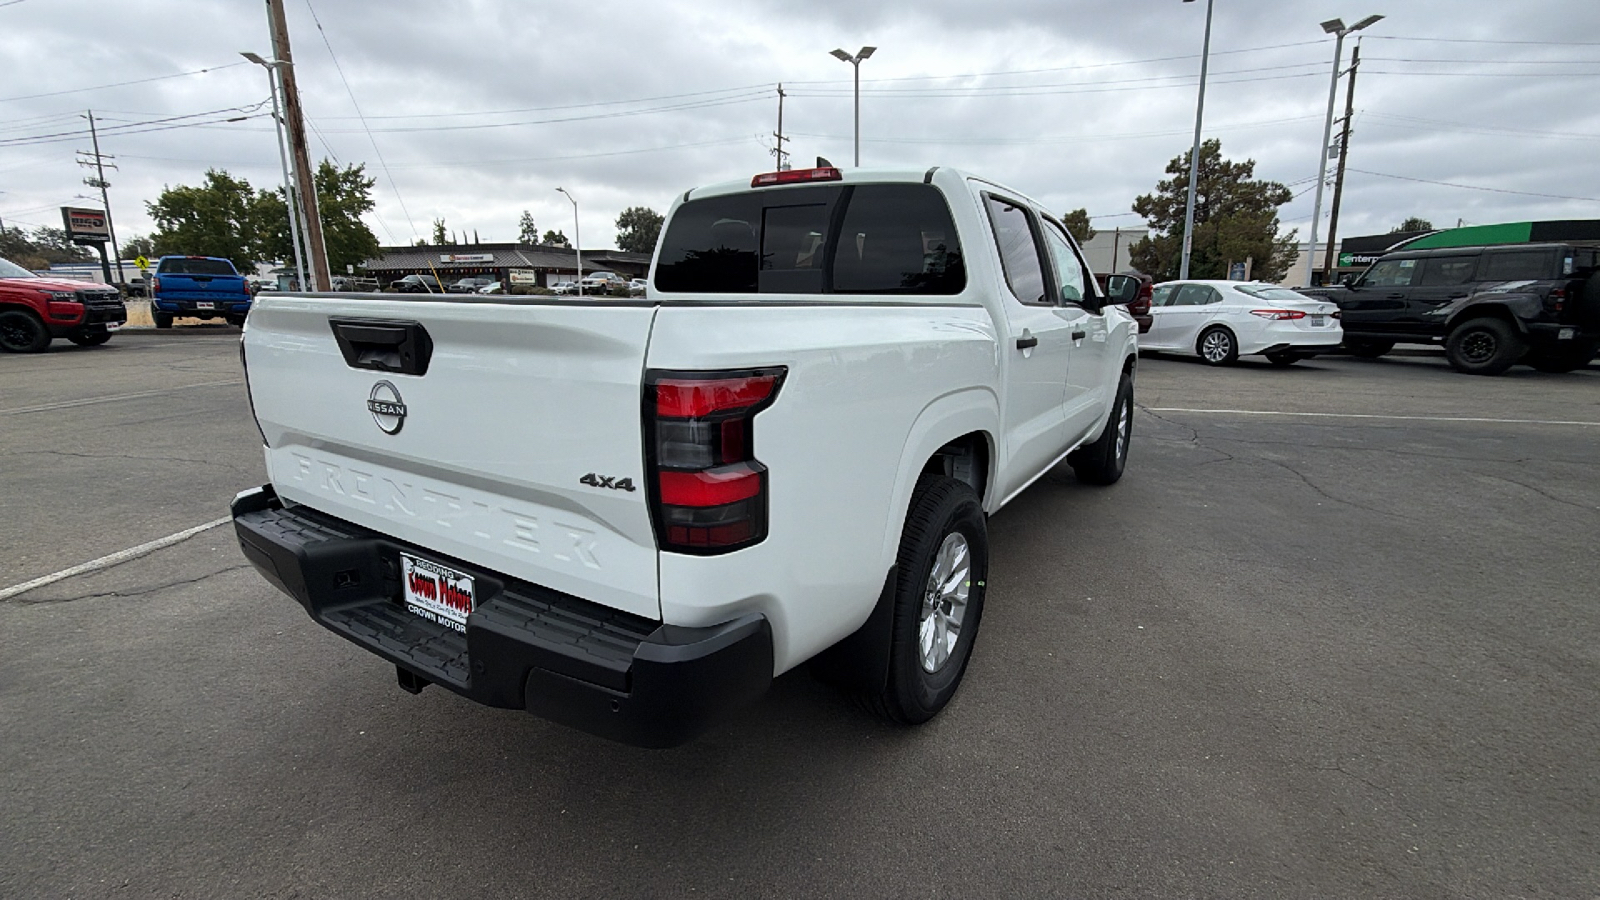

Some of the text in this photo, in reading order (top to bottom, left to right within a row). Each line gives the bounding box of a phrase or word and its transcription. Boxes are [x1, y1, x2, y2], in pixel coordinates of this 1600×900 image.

[1340, 255, 1379, 264] enterp
[367, 401, 404, 415] NISSAN
[291, 451, 601, 570] FRONTIER
[416, 560, 454, 579] REDDING
[408, 571, 437, 601] Crown
[439, 574, 473, 614] Motors
[408, 604, 467, 635] CROWN MOTOR
